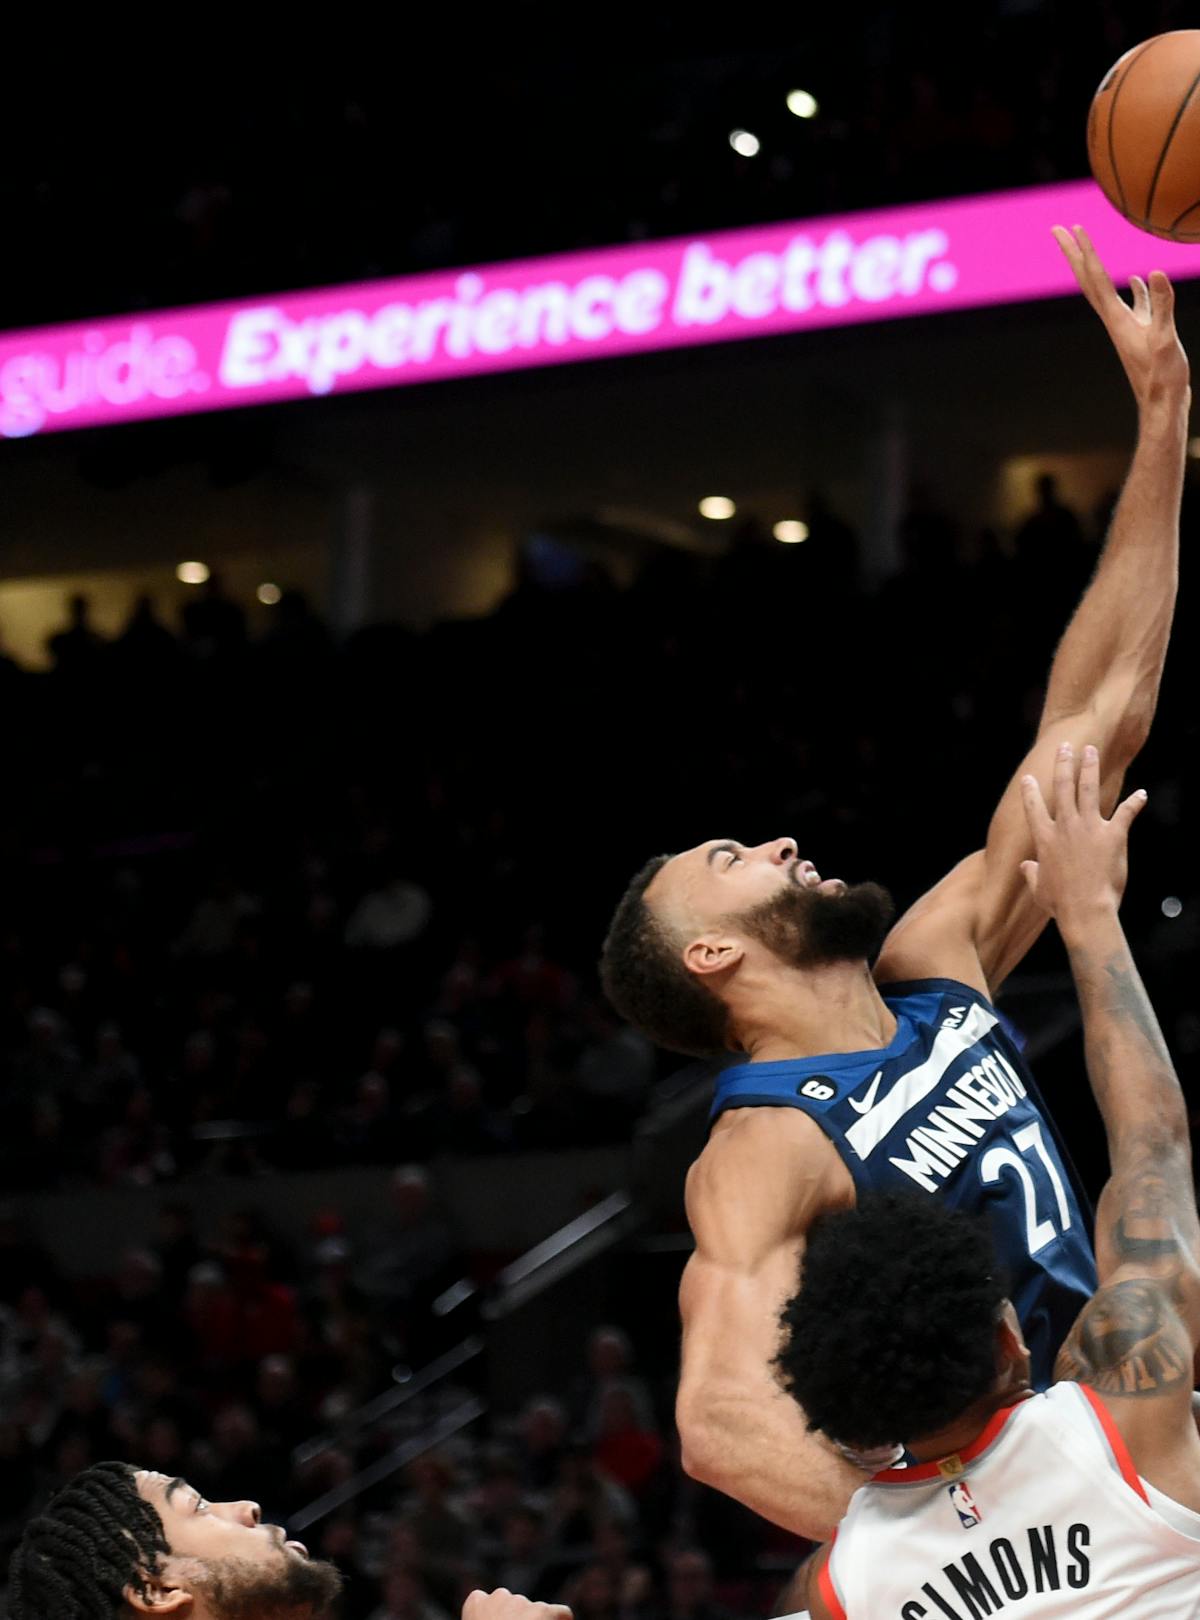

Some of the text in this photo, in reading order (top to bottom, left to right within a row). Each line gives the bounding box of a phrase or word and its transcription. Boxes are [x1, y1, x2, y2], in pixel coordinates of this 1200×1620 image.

[0, 228, 957, 436] guide. Experience better.
[801, 1080, 834, 1100] 6
[980, 1121, 1071, 1256] 27
